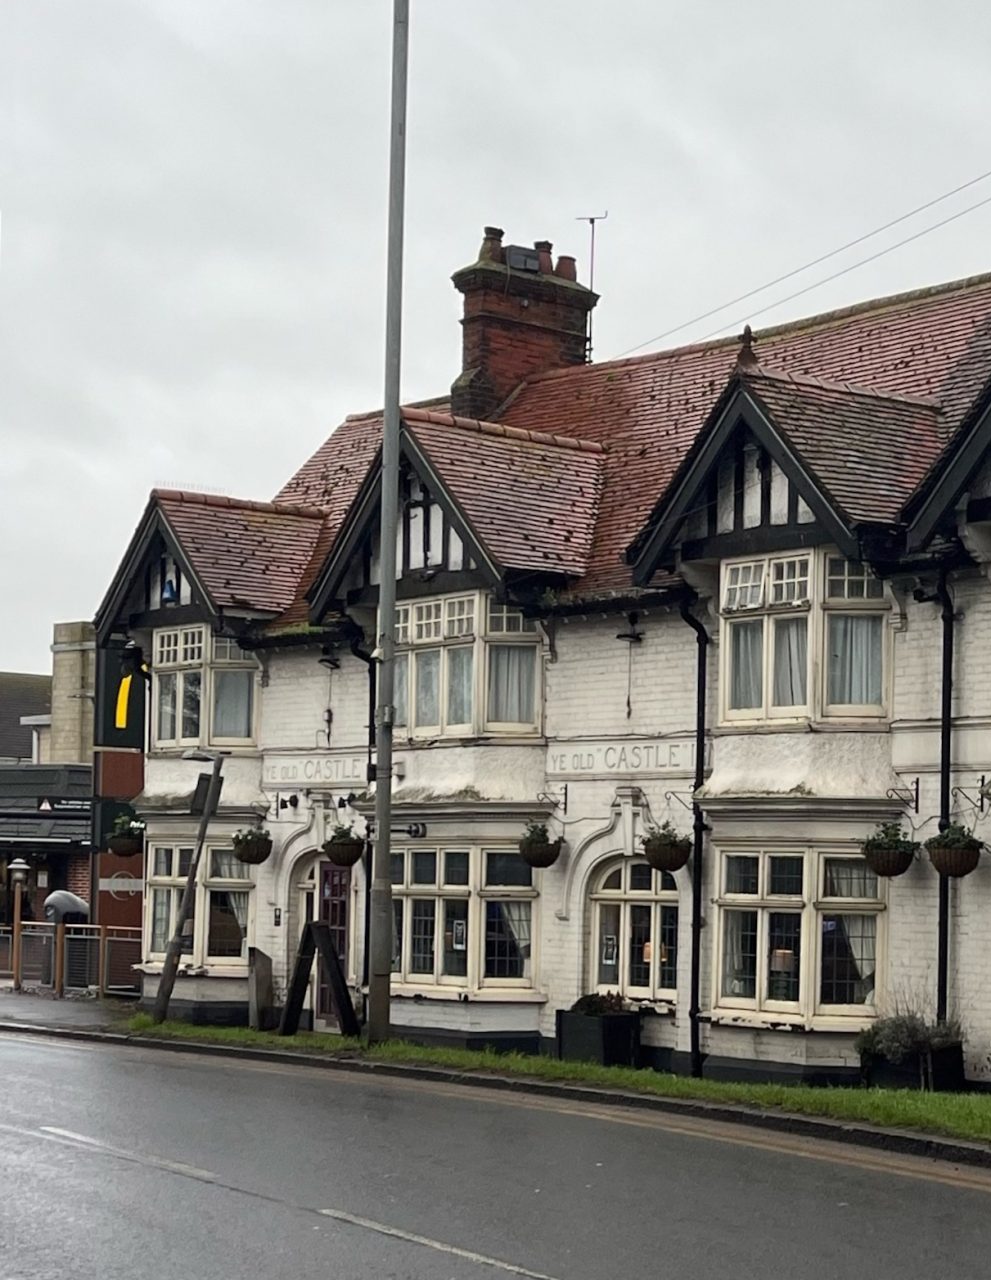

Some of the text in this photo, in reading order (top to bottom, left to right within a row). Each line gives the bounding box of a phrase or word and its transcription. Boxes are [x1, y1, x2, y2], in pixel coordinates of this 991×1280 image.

[551, 753, 567, 770] YE
[572, 753, 595, 770] OLD
[266, 765, 277, 780] YE
[281, 765, 298, 780] OLD
